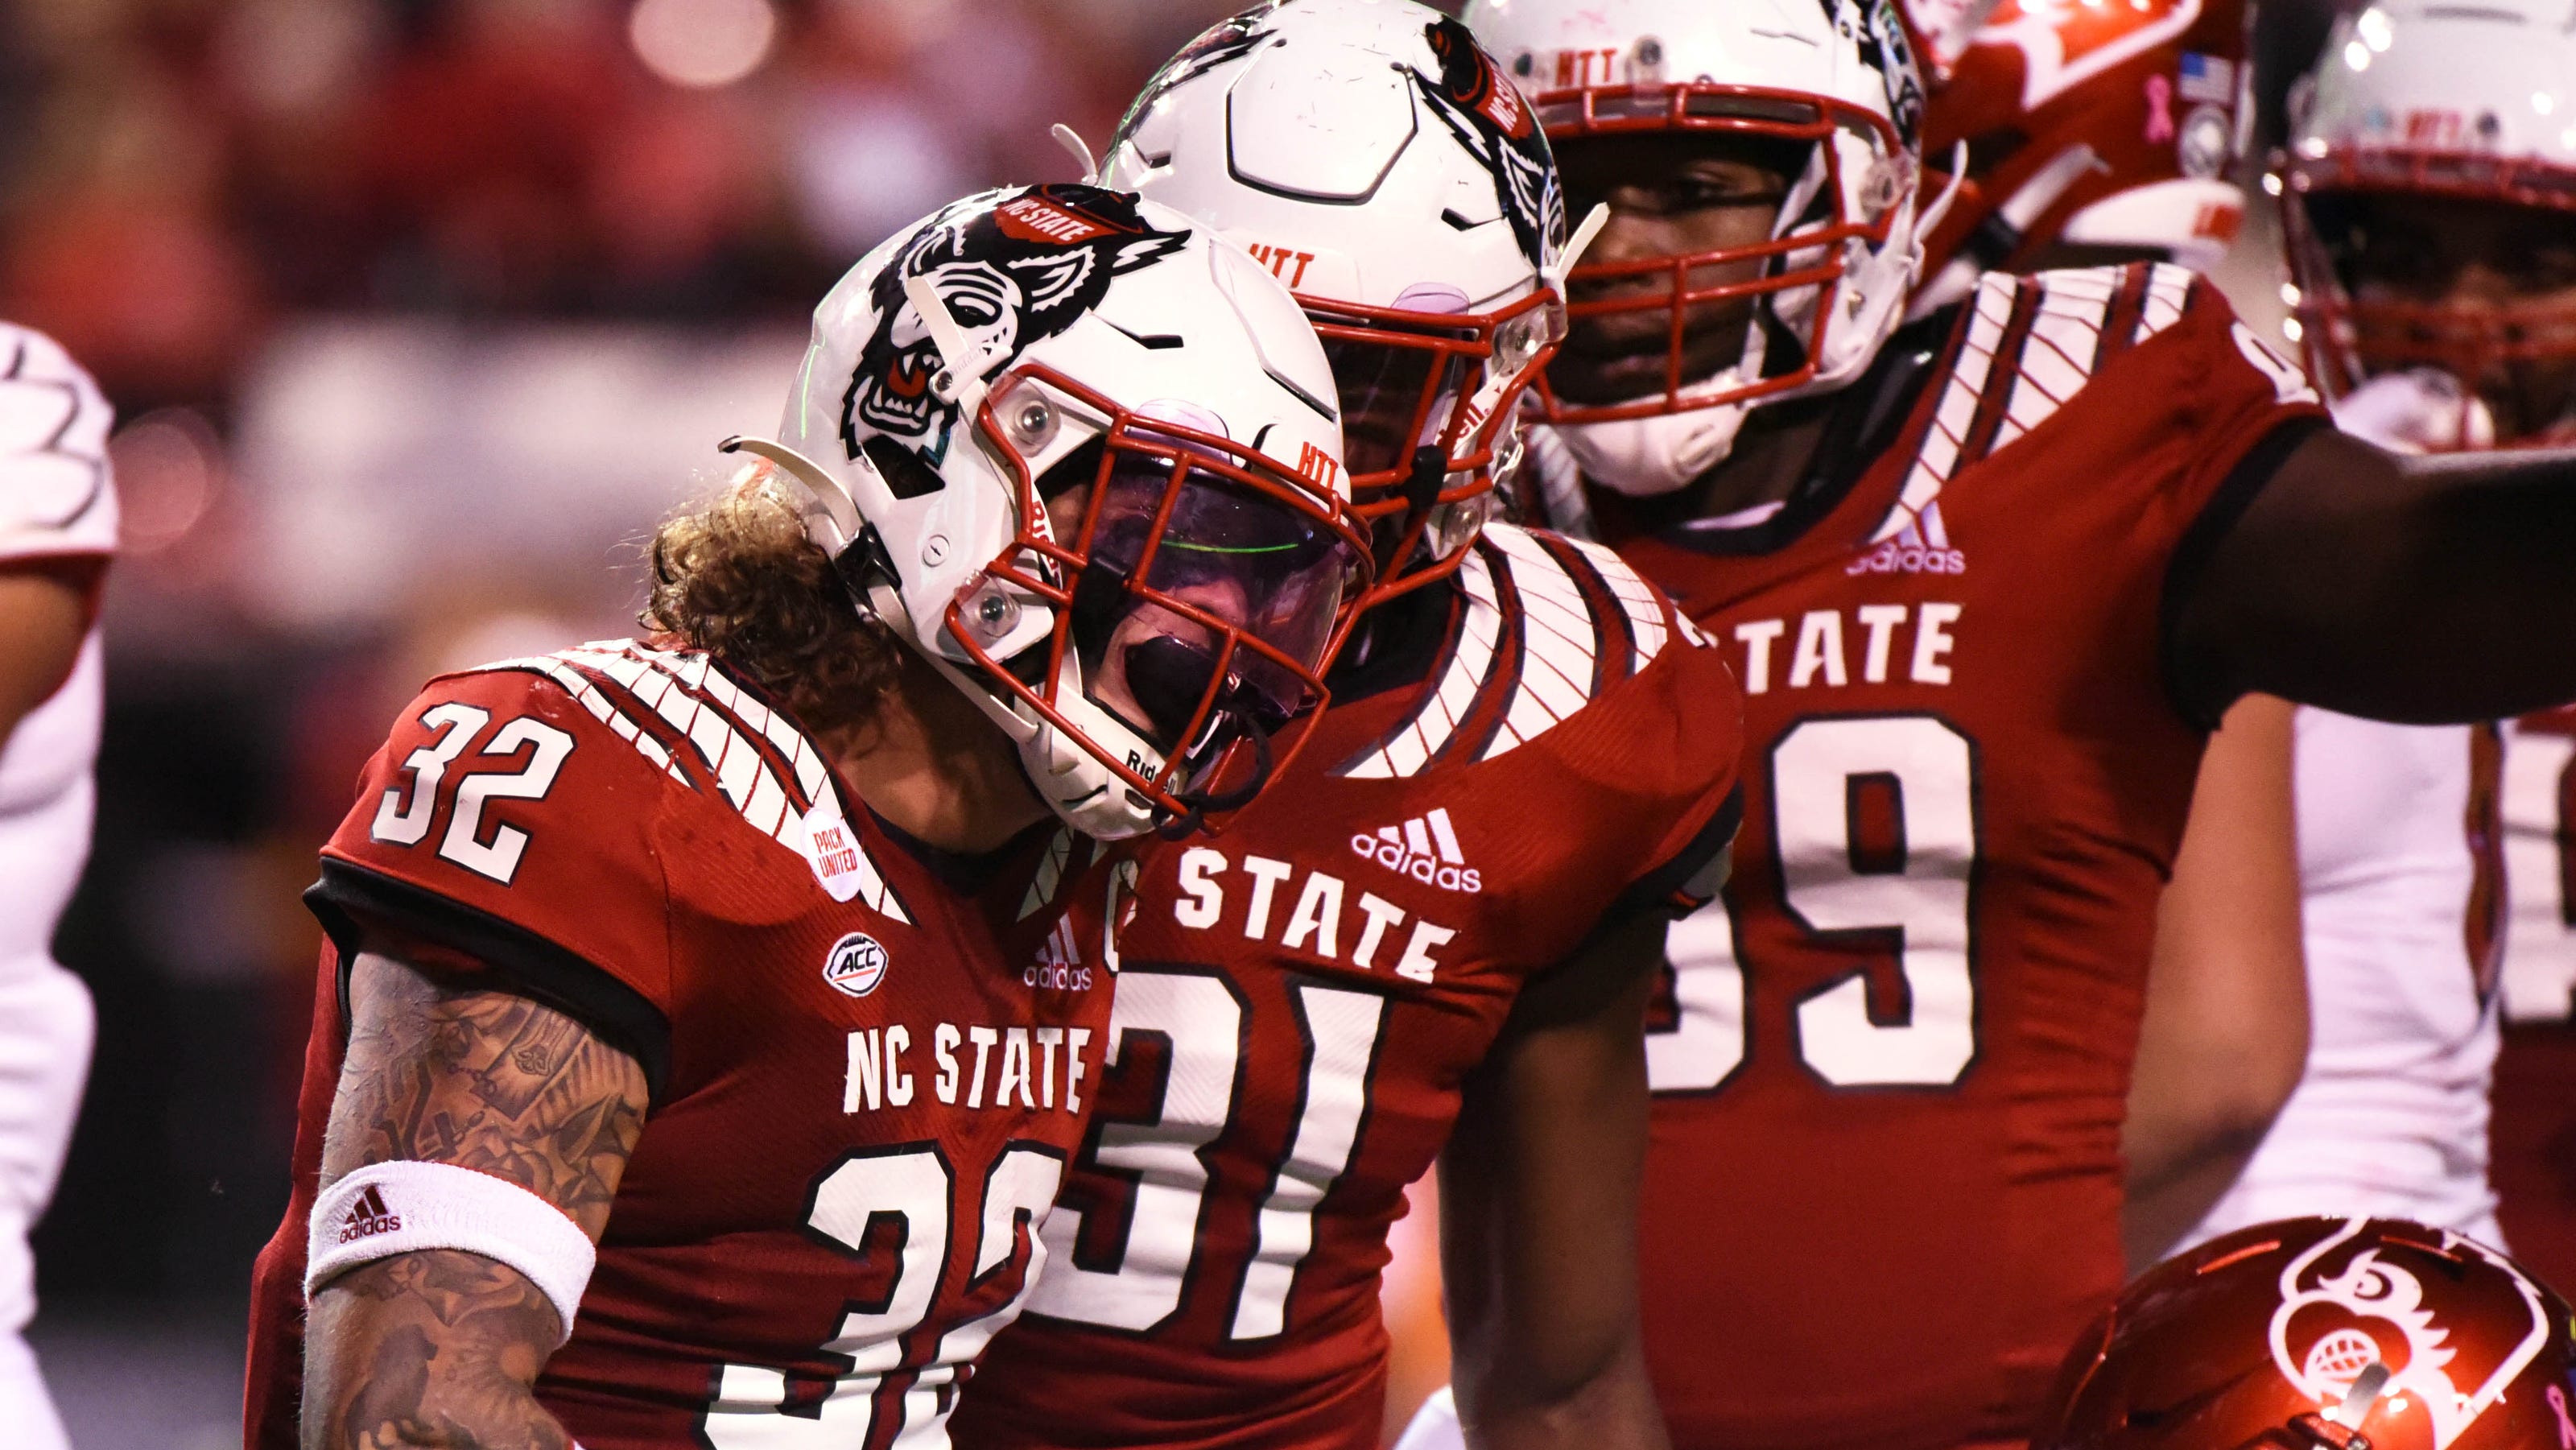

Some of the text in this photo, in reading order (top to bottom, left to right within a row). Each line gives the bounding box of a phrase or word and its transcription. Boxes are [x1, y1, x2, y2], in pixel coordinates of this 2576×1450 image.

[1555, 48, 1617, 88] HTT
[1019, 208, 1095, 242] STATE
[1297, 440, 1339, 490] HTT
[1701, 601, 1963, 695] TATE
[370, 700, 578, 887] 32
[812, 826, 845, 854] PACK
[818, 848, 858, 878] UNITED
[1351, 832, 1483, 894] adidas
[1174, 845, 1459, 984] STATE
[836, 944, 878, 975] ACC
[1023, 961, 1093, 991] adidas
[843, 1022, 1092, 1114] NC STATE
[1022, 971, 1385, 1341] 31
[339, 1215, 402, 1245] adidas
